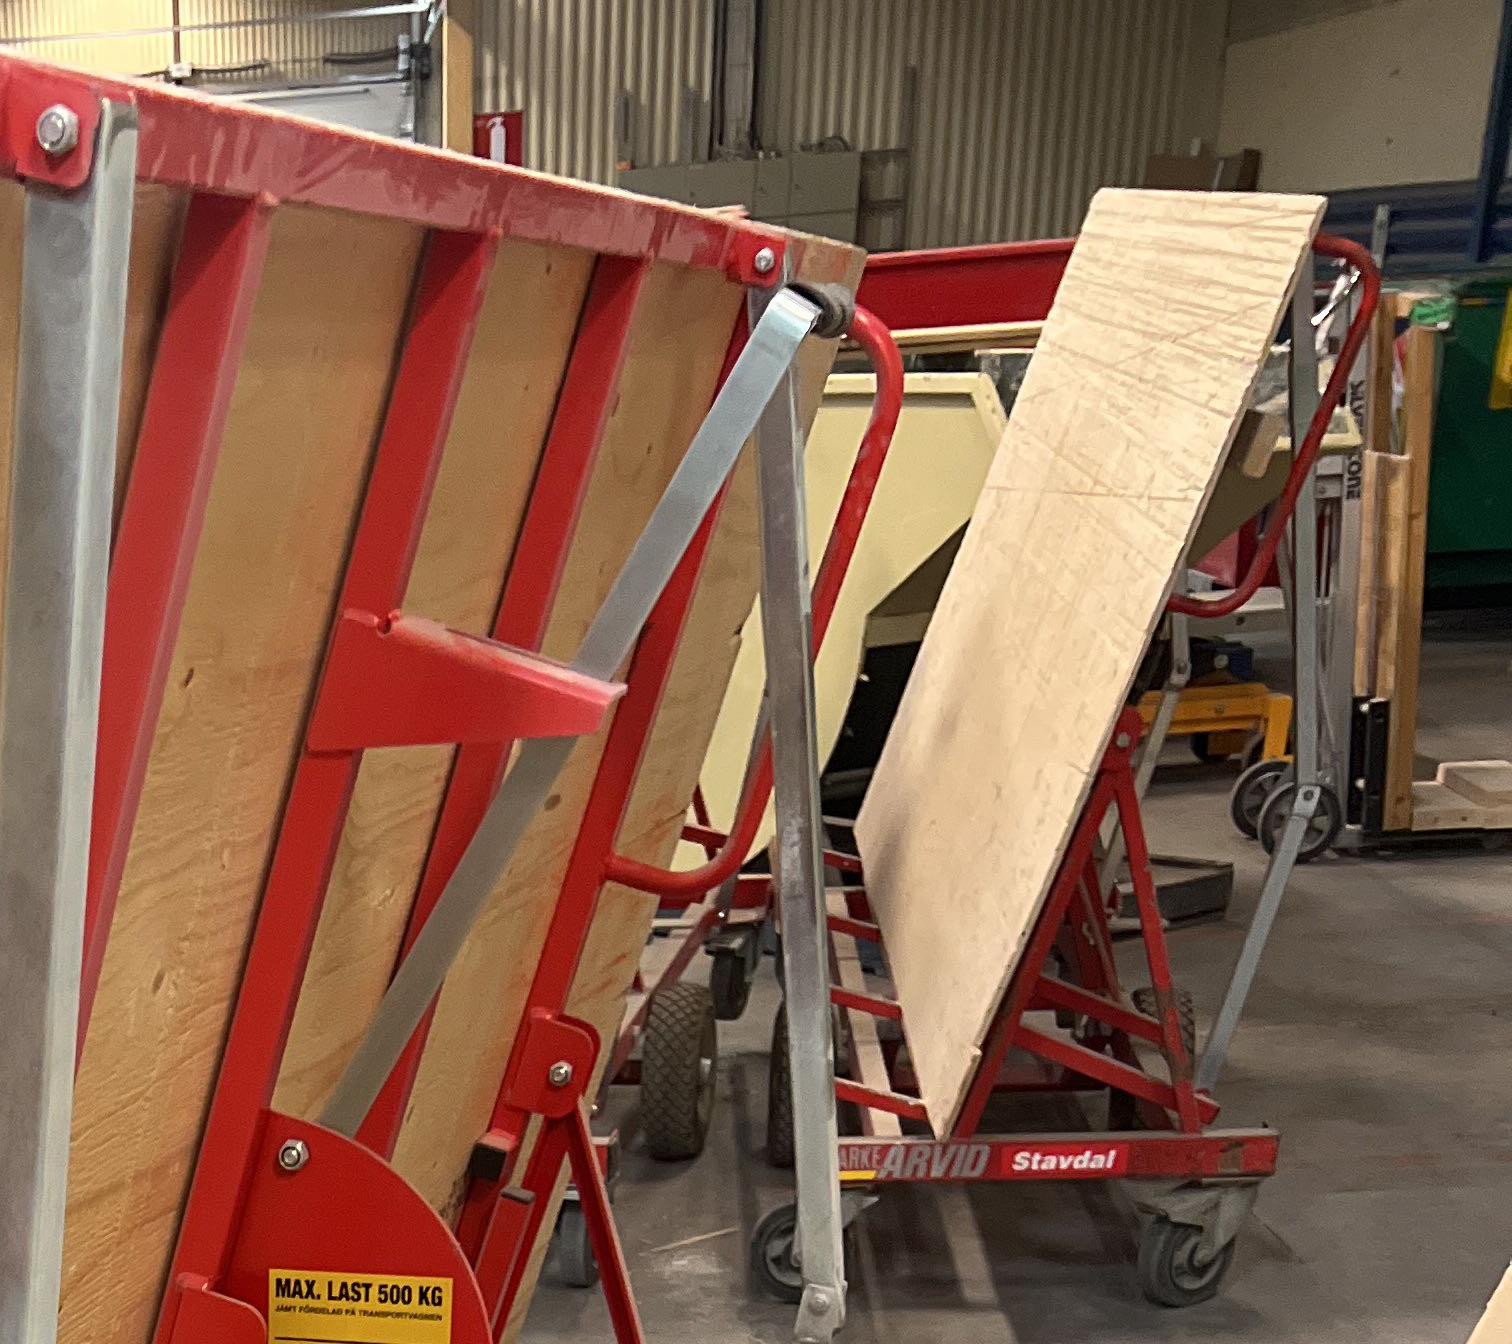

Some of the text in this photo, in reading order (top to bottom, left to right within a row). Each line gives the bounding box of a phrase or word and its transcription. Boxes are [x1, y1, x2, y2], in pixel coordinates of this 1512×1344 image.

[838, 1143, 989, 1179] ARKE ARVID
[1011, 1149, 1116, 1171] Stavdal
[275, 1277, 443, 1307] MAX. LAST 500 KG
